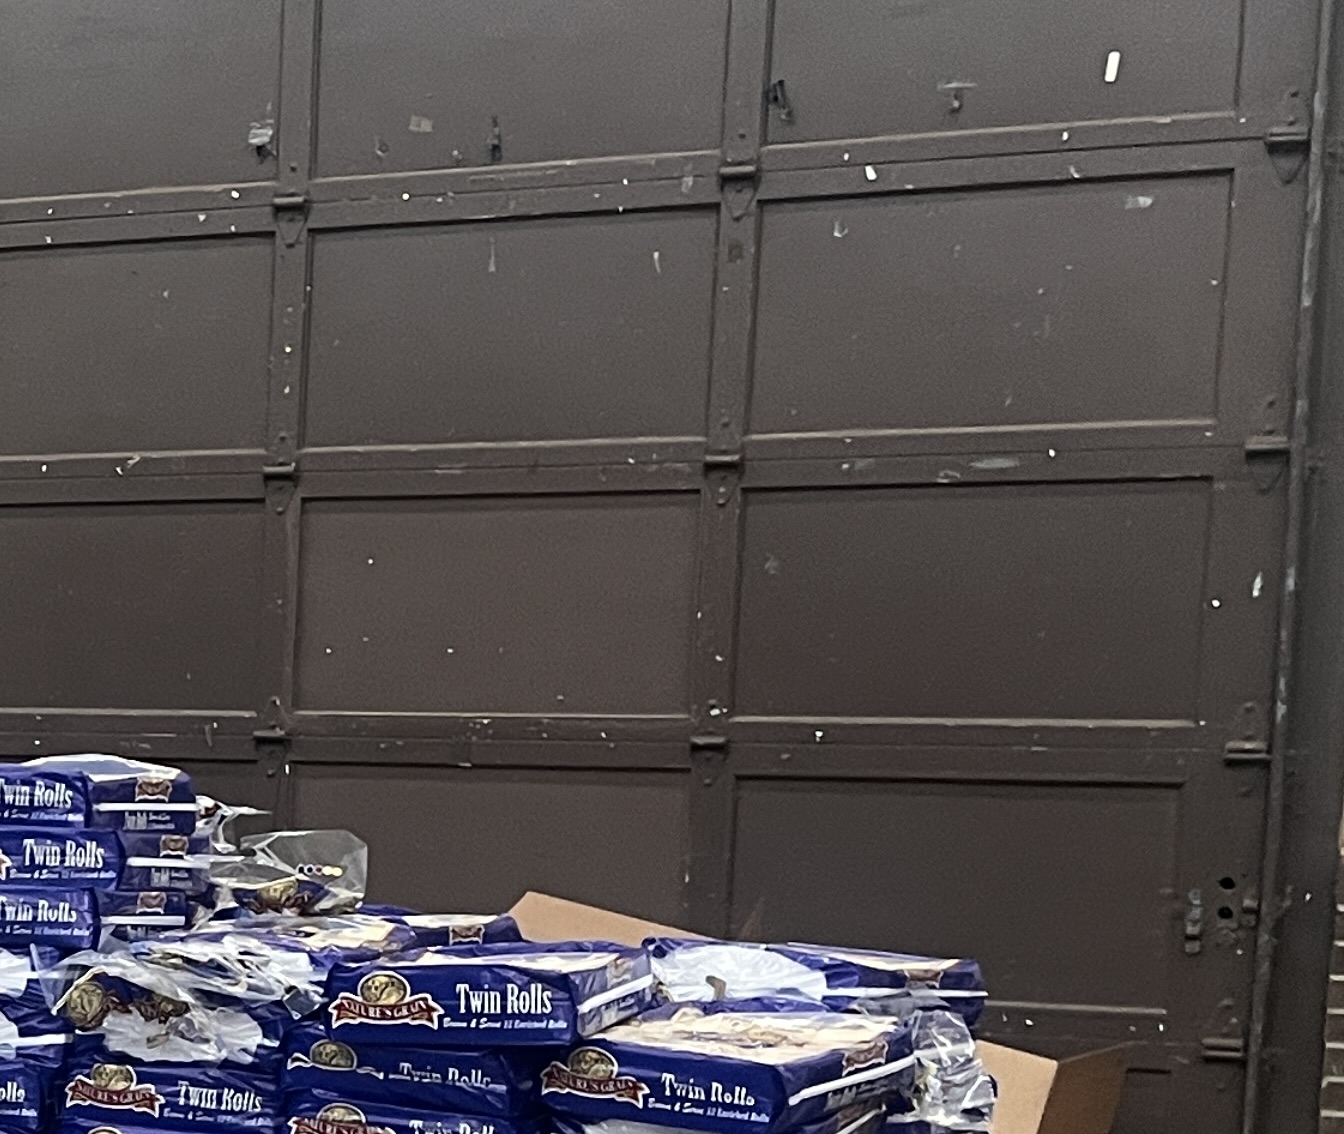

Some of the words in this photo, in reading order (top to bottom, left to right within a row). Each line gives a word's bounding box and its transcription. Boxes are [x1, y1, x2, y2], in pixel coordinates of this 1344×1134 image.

[33, 780, 73, 809] Rolls
[23, 839, 61, 867] Twin
[64, 839, 106, 869] Rolls
[342, 999, 391, 1019] NATURE'S
[394, 1000, 429, 1019] GRAIN
[456, 983, 501, 1014] Twin
[506, 983, 553, 1014] Rolls
[178, 1080, 217, 1109] Twin
[221, 1087, 263, 1113] Rolls
[662, 1072, 705, 1101] Twin
